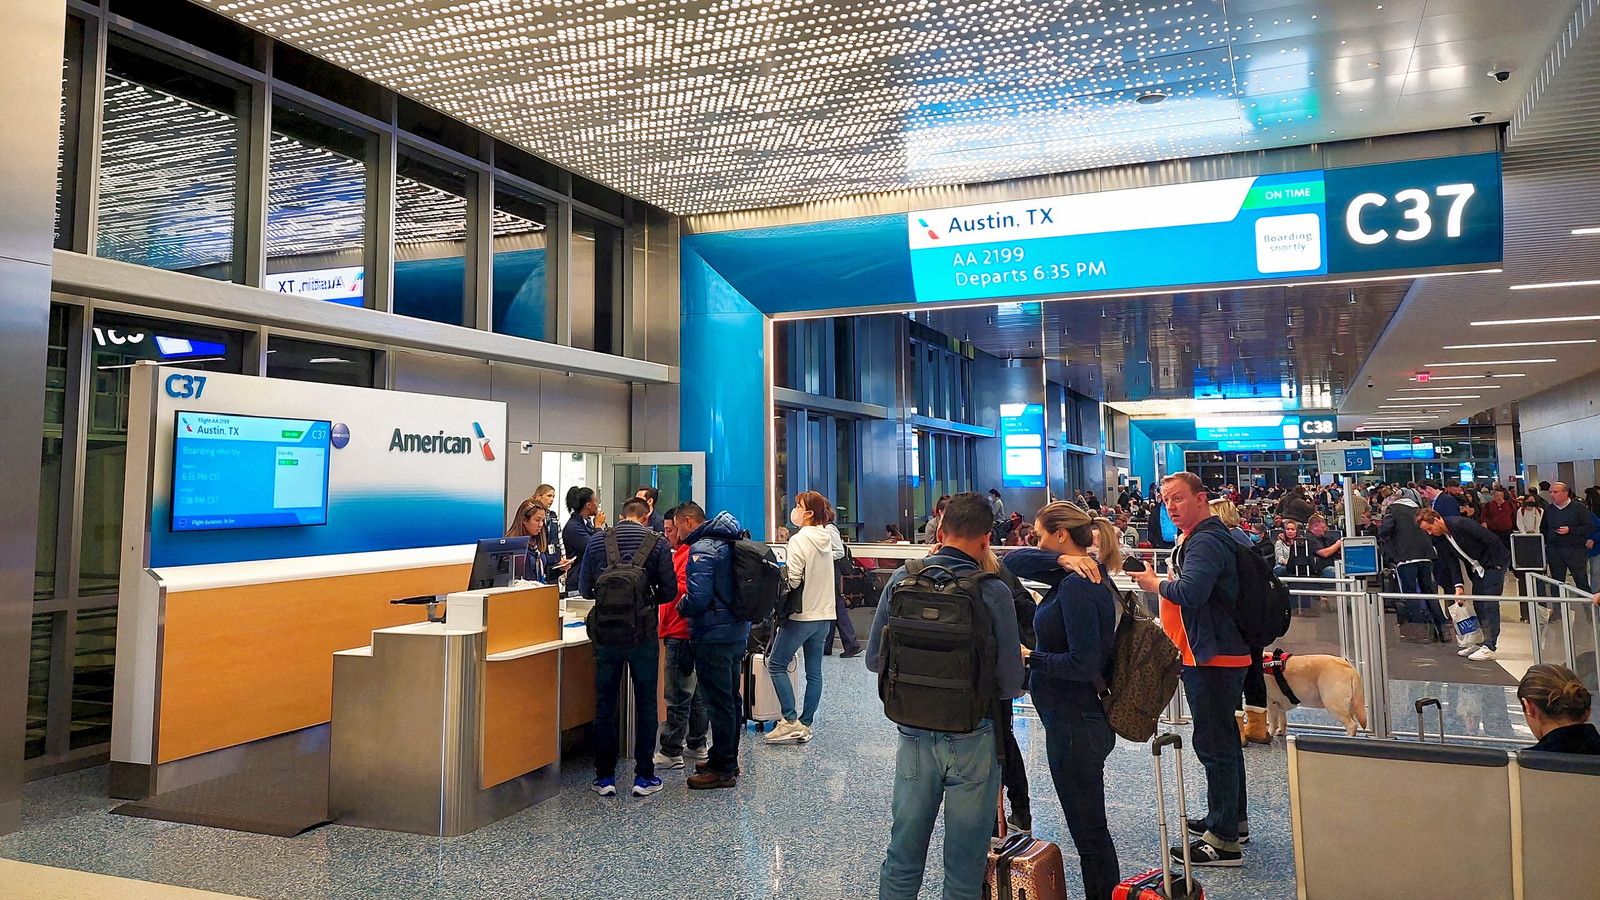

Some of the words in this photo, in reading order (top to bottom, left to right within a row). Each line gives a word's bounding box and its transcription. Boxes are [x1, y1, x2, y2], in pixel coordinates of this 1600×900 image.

[1264, 190, 1283, 200] ON
[1285, 188, 1311, 198] TIME
[948, 211, 1020, 233] Austin,
[1026, 207, 1054, 226] TX
[1346, 183, 1476, 245] C37
[1263, 232, 1313, 243] Boarding
[1269, 242, 1307, 253] shortly
[953, 251, 978, 267] AA
[982, 246, 1025, 265] 2199
[955, 268, 1028, 288] Departs
[1033, 263, 1070, 281] 6:35
[1077, 260, 1107, 277] PM
[165, 373, 207, 399] C37
[197, 425, 227, 436] Austin,
[228, 426, 240, 436] TX
[1302, 420, 1334, 434] C38
[311, 430, 327, 440] C37
[388, 428, 472, 454] American
[183, 446, 216, 457] Boarding
[216, 447, 241, 458] shortly
[1322, 459, 1336, 467] 1-4
[1347, 457, 1363, 467] 5-9
[197, 473, 208, 481] PM
[194, 496, 206, 504] PM
